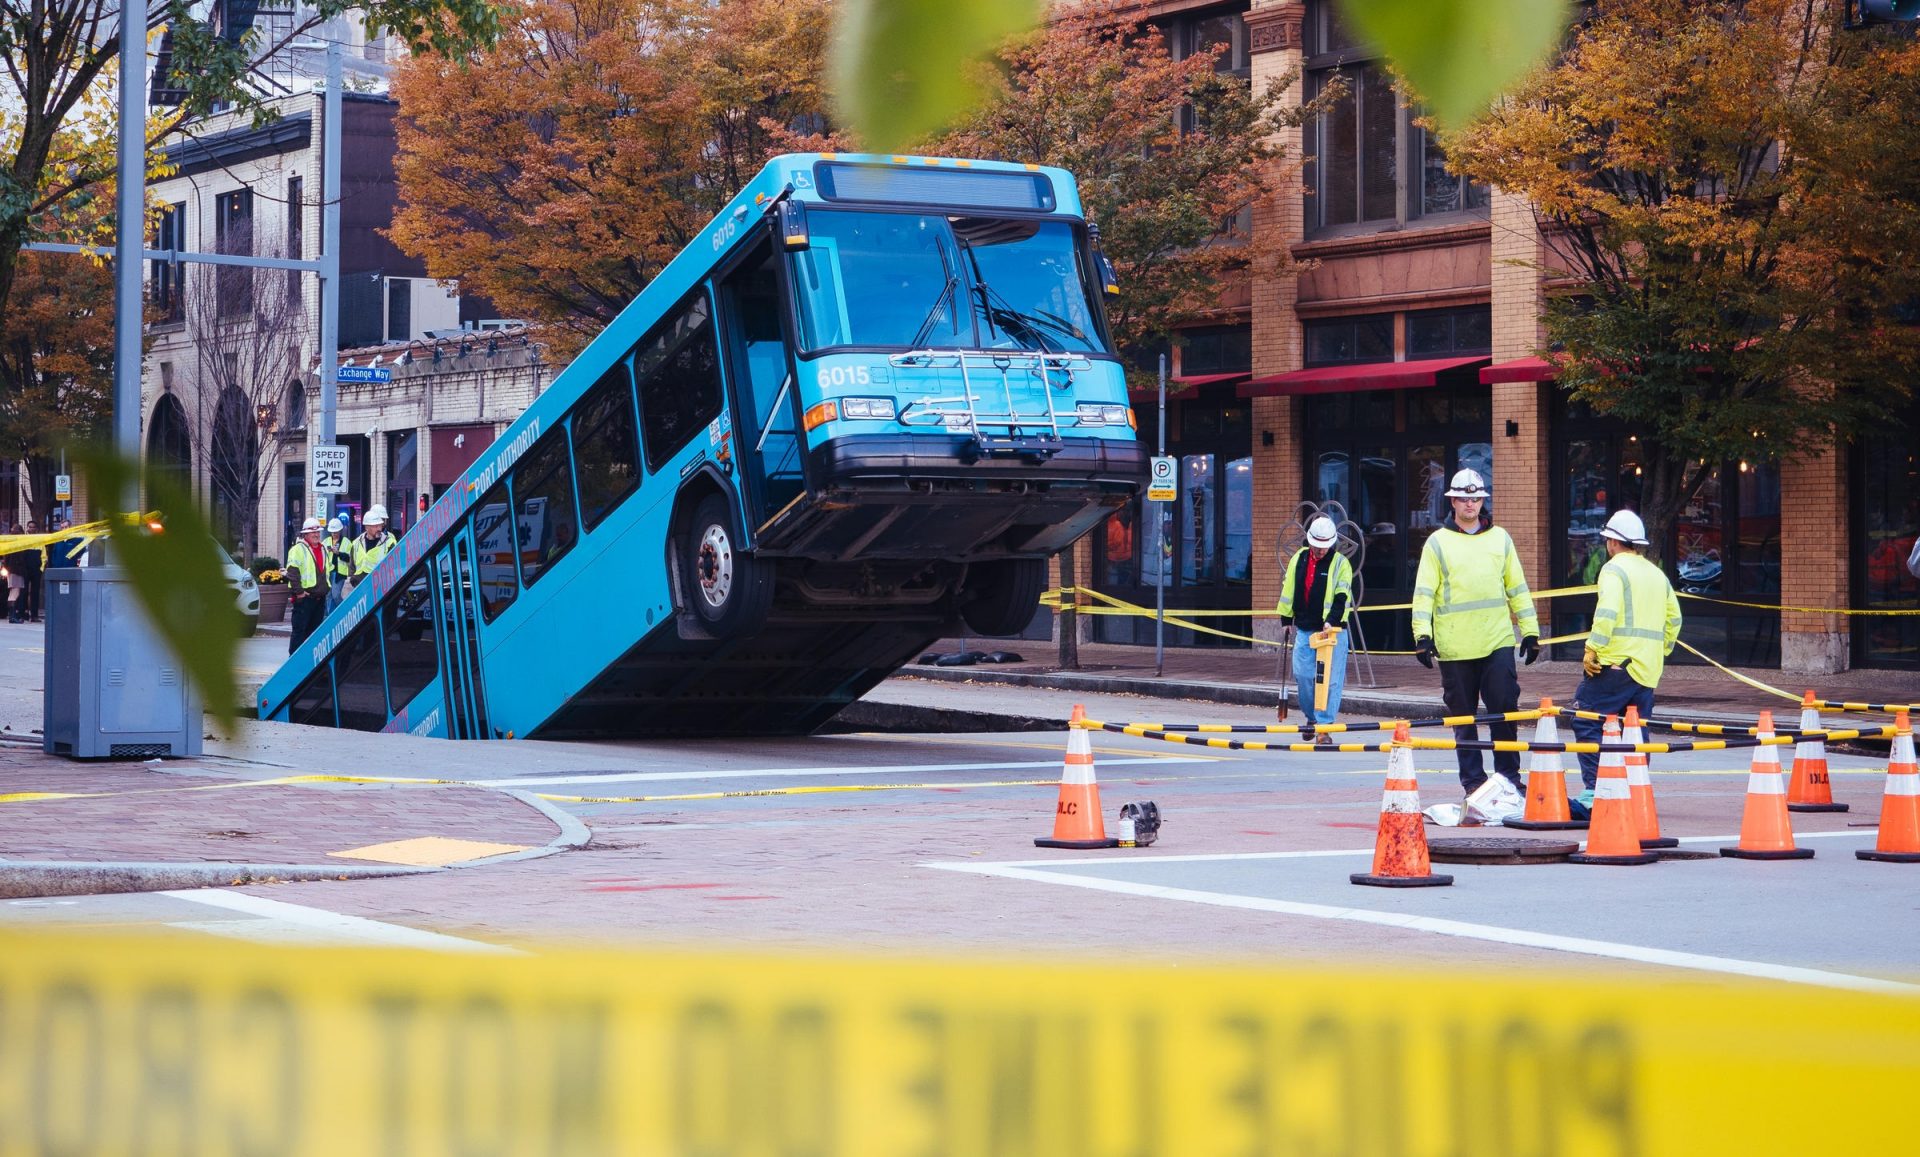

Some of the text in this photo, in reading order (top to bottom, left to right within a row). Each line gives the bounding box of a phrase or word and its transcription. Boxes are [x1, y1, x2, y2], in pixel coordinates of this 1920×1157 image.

[712, 216, 735, 251] 6015
[338, 367, 389, 381] Exchange Way
[817, 365, 870, 388] 6015
[315, 450, 346, 460] SPEED
[317, 461, 342, 469] LIMIT
[474, 415, 540, 499] PORT AUTHORITY
[315, 470, 344, 488] 25
[372, 547, 402, 605] PORT
[405, 474, 469, 564] AUTHORITY
[312, 594, 368, 667] PORT AUTHORITY
[410, 707, 439, 737] THORITY
